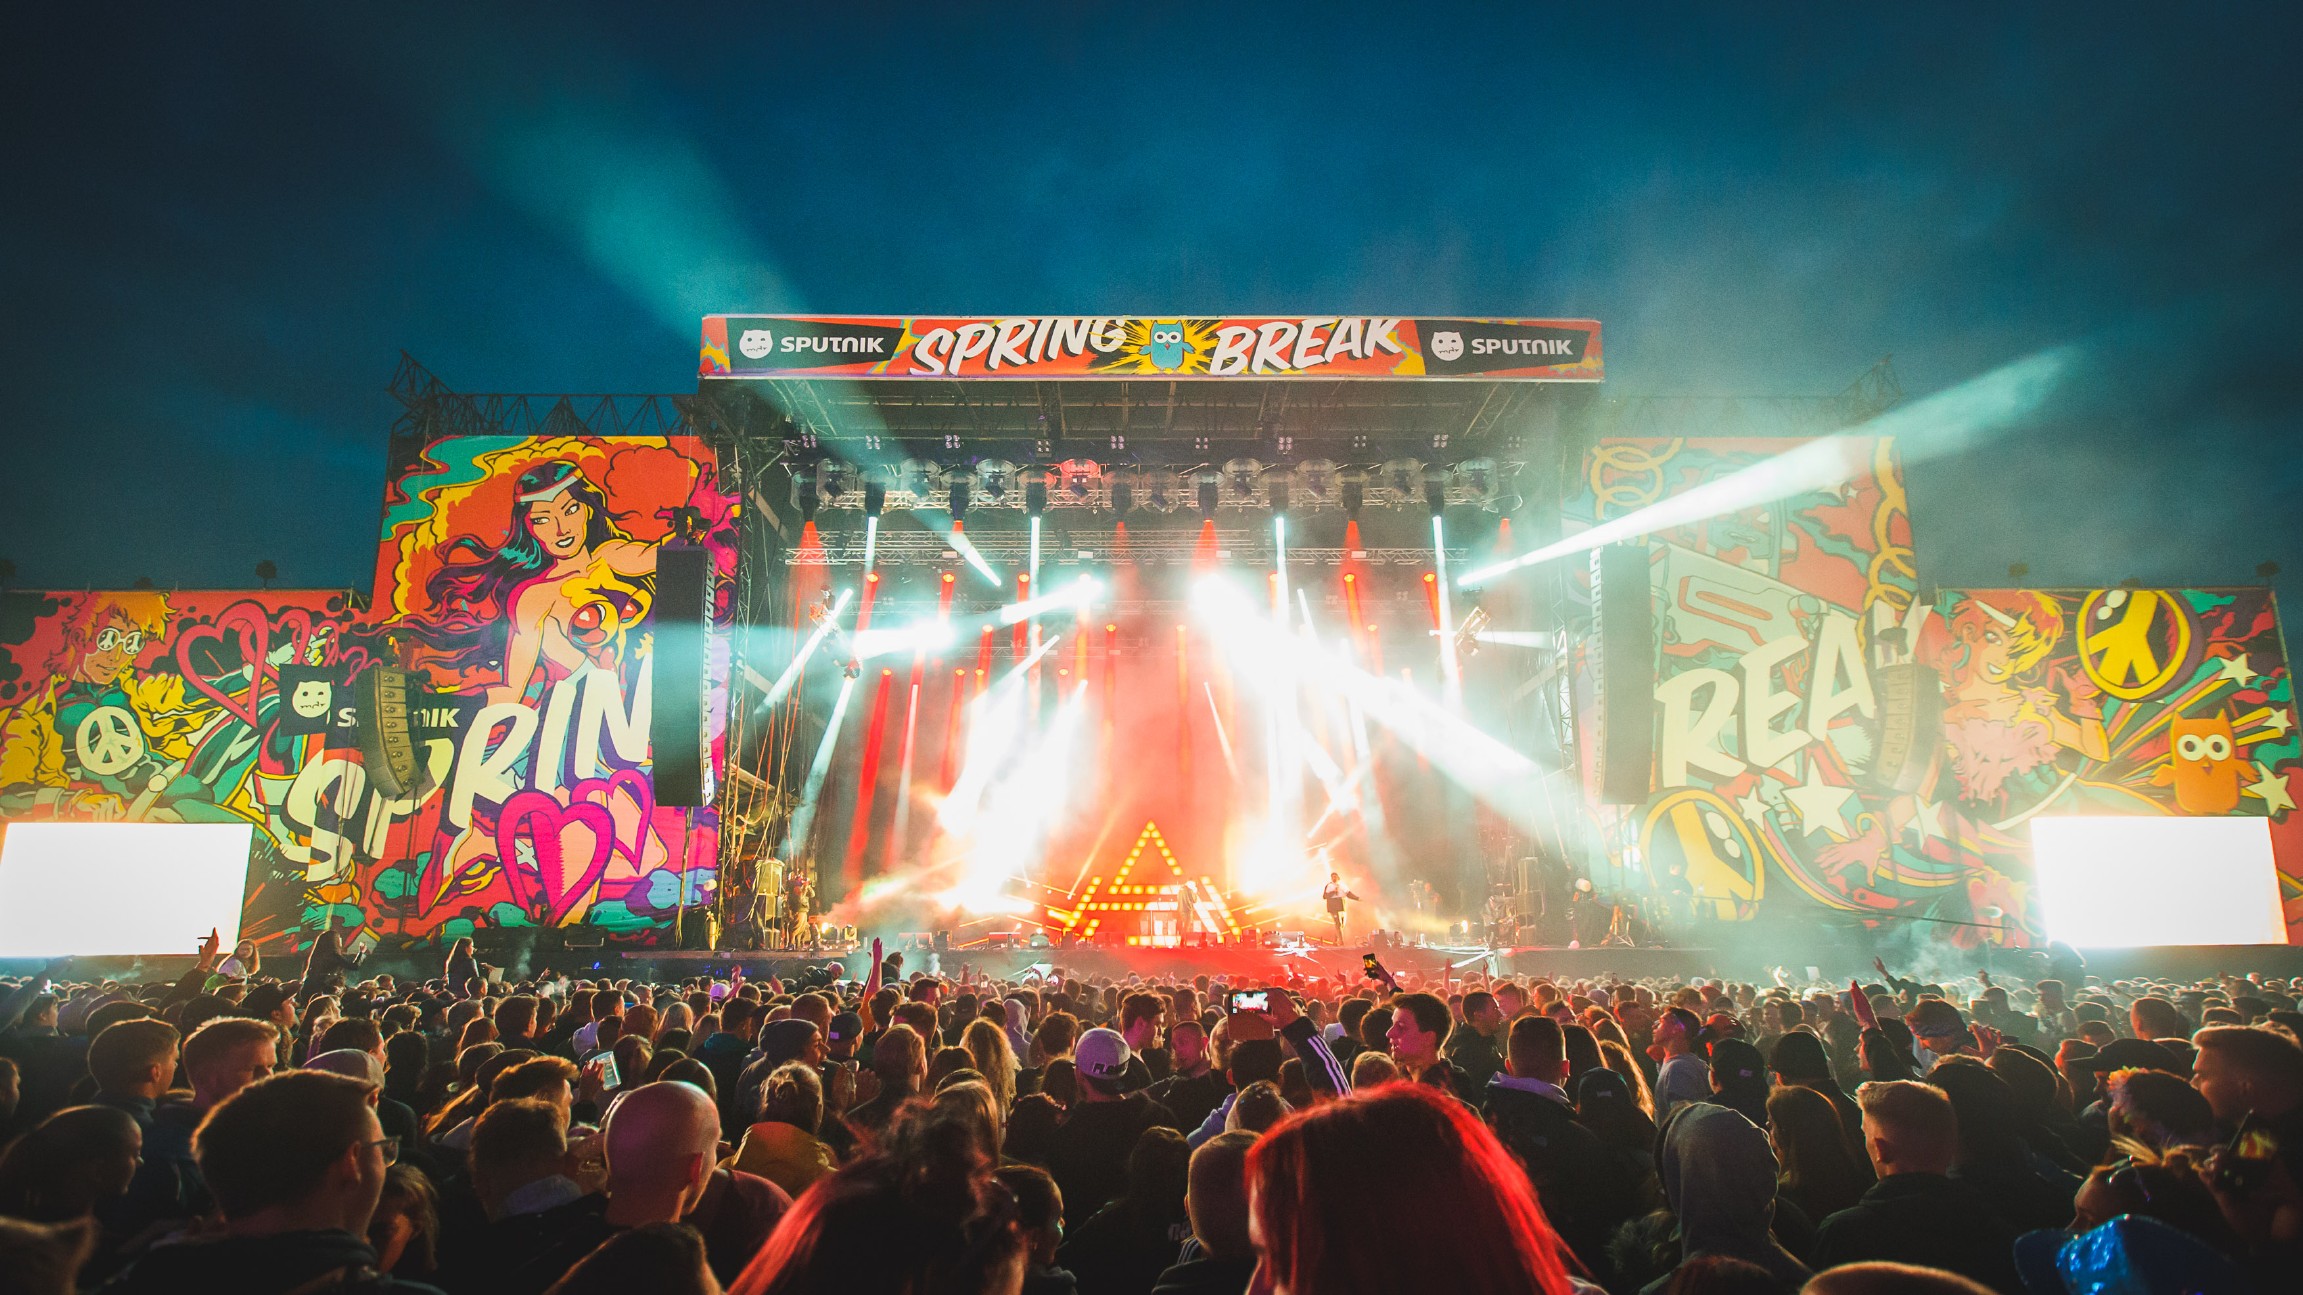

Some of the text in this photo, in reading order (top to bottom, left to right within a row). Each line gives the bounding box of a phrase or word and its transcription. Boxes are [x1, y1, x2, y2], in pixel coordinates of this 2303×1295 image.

[780, 336, 884, 353] SPUTNIK
[909, 318, 1404, 376] SPRING BREAK
[1471, 338, 1574, 355] SPUTNIK
[1655, 595, 1933, 788] REA
[337, 707, 460, 728] SNIK
[279, 653, 652, 882] SPRIN
